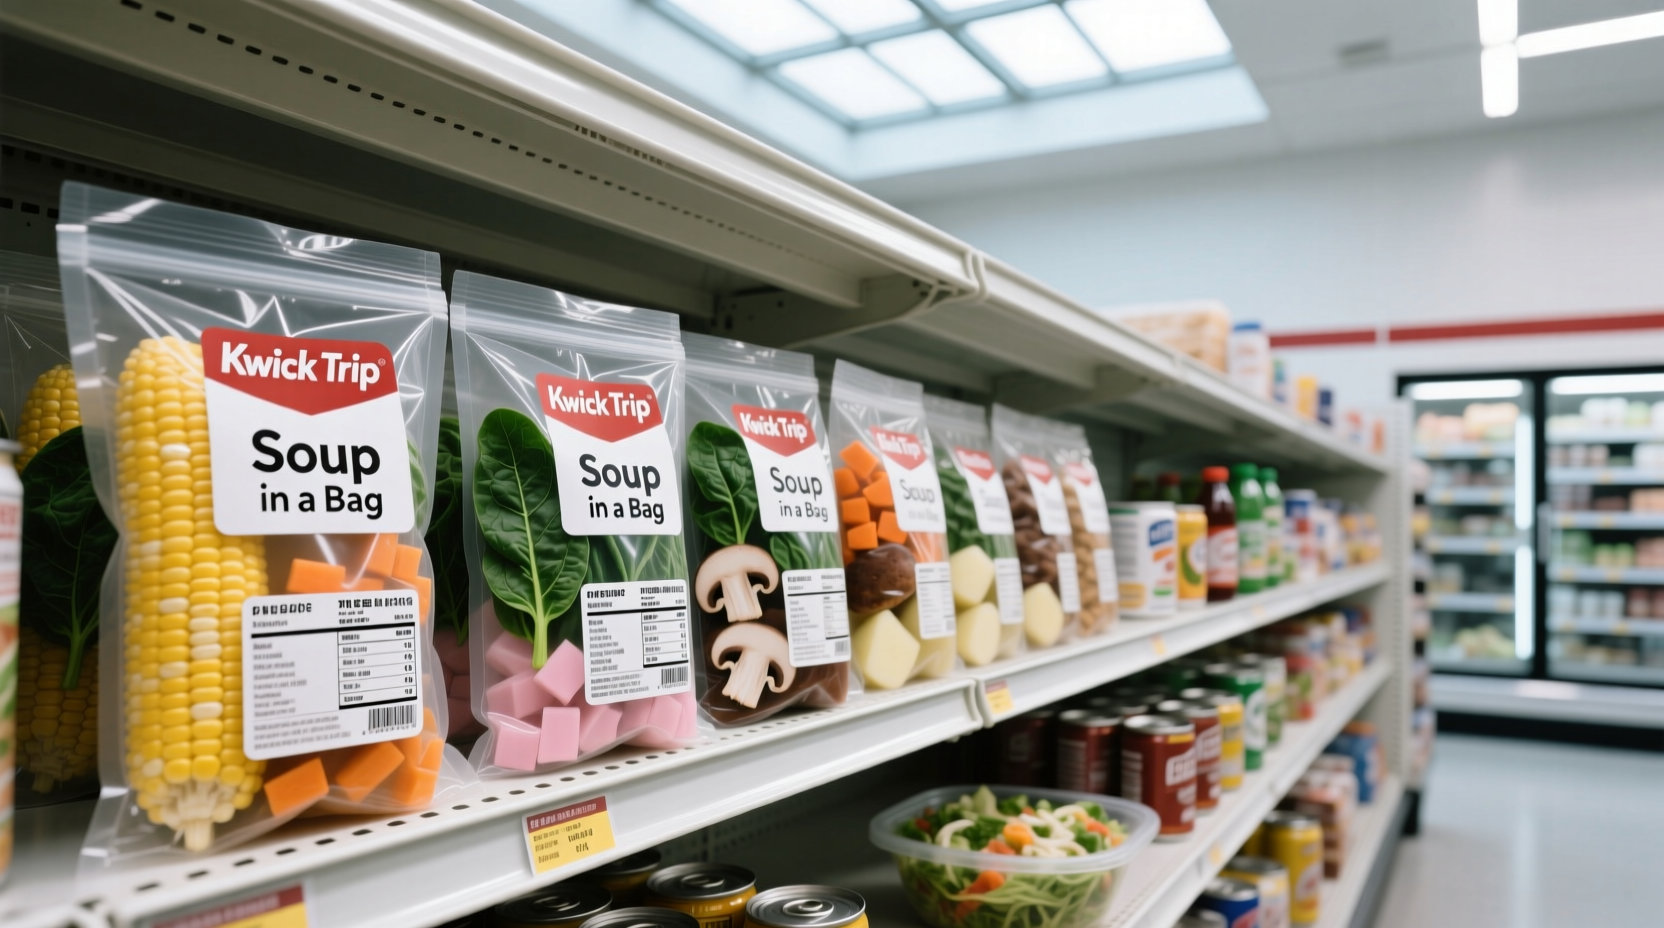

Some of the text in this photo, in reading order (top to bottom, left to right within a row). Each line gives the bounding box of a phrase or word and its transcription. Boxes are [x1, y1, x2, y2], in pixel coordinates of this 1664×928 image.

[221, 341, 318, 382] Kwick
[547, 384, 610, 416] Kwick
[251, 429, 381, 485] Soup
[579, 453, 661, 497] Soup
[260, 482, 383, 520] in a Bag
[769, 466, 823, 501] Soup
[588, 495, 665, 525] in a Bag
[778, 500, 828, 523] in a Bag
